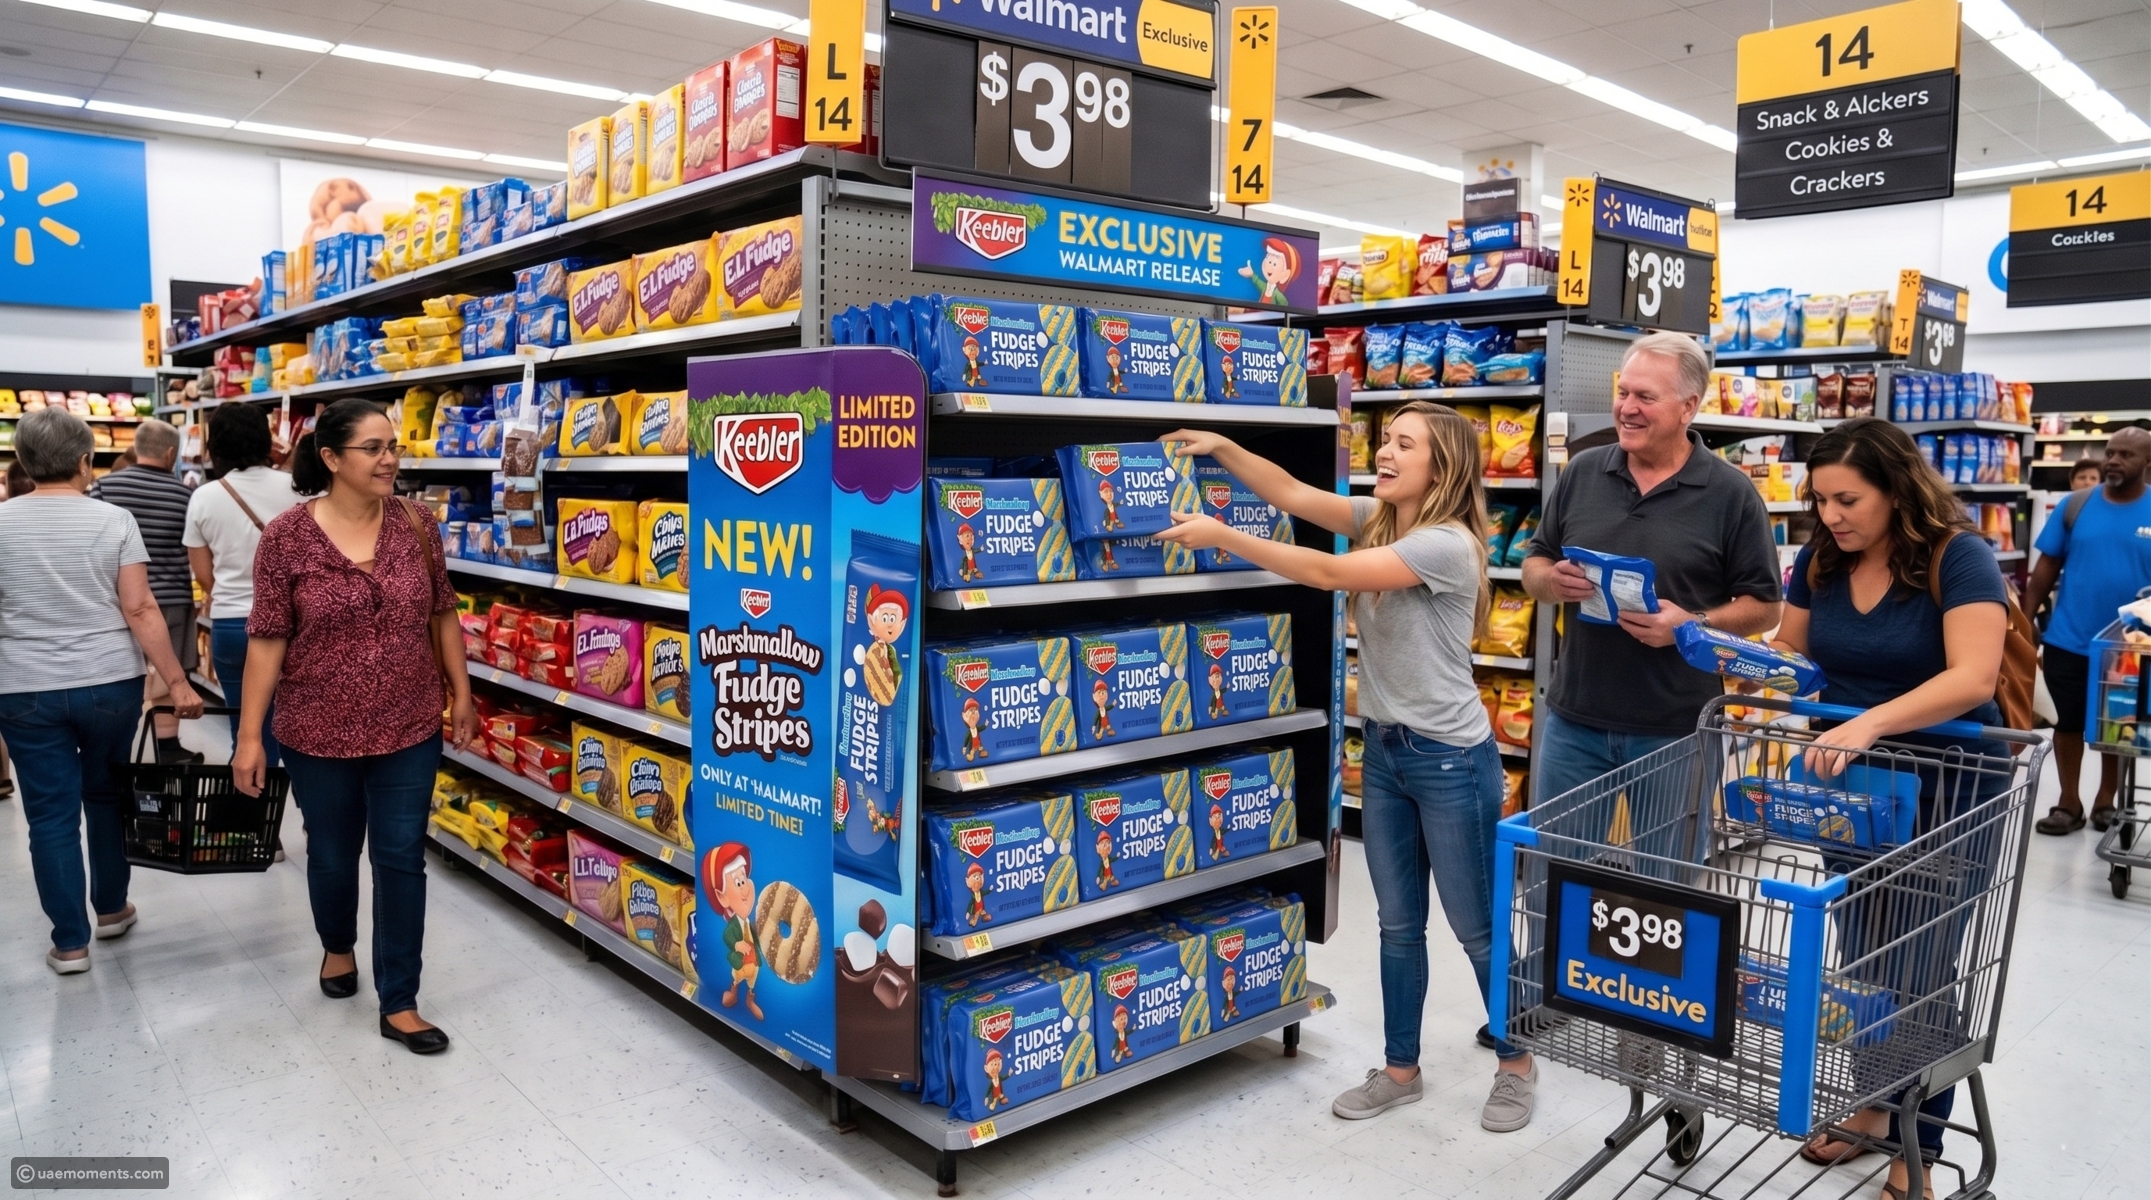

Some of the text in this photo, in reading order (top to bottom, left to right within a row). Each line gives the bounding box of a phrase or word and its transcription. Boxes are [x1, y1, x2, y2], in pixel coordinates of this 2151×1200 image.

[1143, 22, 1209, 52] Exclusive
[1815, 25, 1874, 77] 14
[827, 43, 847, 80] L
[815, 96, 852, 131] 14
[1757, 104, 1817, 130] Snack
[1824, 100, 1840, 120] &
[1242, 119, 1262, 151] 7
[1785, 128, 1893, 160] Cookies &
[1231, 164, 1264, 194] 14
[1790, 170, 1885, 195] Crackers
[2065, 186, 2107, 217] 14
[961, 208, 1024, 245] Keebler
[1626, 203, 1685, 237] Walmart
[1060, 211, 1223, 263] EXCLUSIVE
[1059, 249, 1221, 287] WALMART RELEASE
[1571, 250, 1581, 270] L
[1562, 278, 1584, 297] 14
[991, 331, 1036, 351] FUDGE
[1131, 342, 1169, 360] FUDGE
[1895, 336, 1909, 351] 14
[991, 350, 1038, 369] STRIPES
[1131, 360, 1171, 378] STRIPES
[1242, 351, 1276, 368] FUDGE
[1242, 369, 1278, 385] STRIPES
[840, 395, 916, 419] LIMITED
[717, 420, 800, 463] Keebler
[838, 425, 916, 448] EDITION
[1123, 471, 1166, 488] FUDGE
[1126, 490, 1170, 508] STRIPES
[986, 514, 1033, 534] FUDGE
[1233, 506, 1268, 523] FUDGE
[704, 518, 812, 581] NEW!
[987, 537, 1036, 556] STRIPES
[700, 625, 820, 668] Marshmallow
[1231, 652, 1268, 673] FUDGE
[714, 660, 801, 716] Fudge
[1118, 667, 1159, 690] FUDGE
[1232, 673, 1270, 692] STRIPES
[991, 682, 1038, 708] FUDGE
[1119, 688, 1162, 709] STRIPES
[714, 707, 811, 754] Stripes
[991, 706, 1041, 729] STRIPES
[850, 693, 867, 772] FUDGE
[864, 700, 879, 785] STRIPES
[701, 764, 732, 787] ONLY
[734, 774, 749, 792] AT
[716, 792, 765, 821] LIMITED
[1232, 789, 1270, 814] FUDGE
[1122, 813, 1164, 840] FUDGE
[1232, 808, 1272, 831] STRIPES
[996, 843, 1044, 872] FUDGE
[1122, 834, 1166, 860] STRIPES
[996, 865, 1046, 893] STRIPES
[1245, 945, 1282, 973] FUDGE
[1245, 964, 1283, 991] STRIPES
[1567, 958, 1707, 1024] Exclusive
[1138, 980, 1181, 1012] FUDGE
[1138, 1000, 1182, 1030] STRIPES
[1015, 1021, 1062, 1055] FUDGE
[1014, 1043, 1064, 1075] STRIPES
